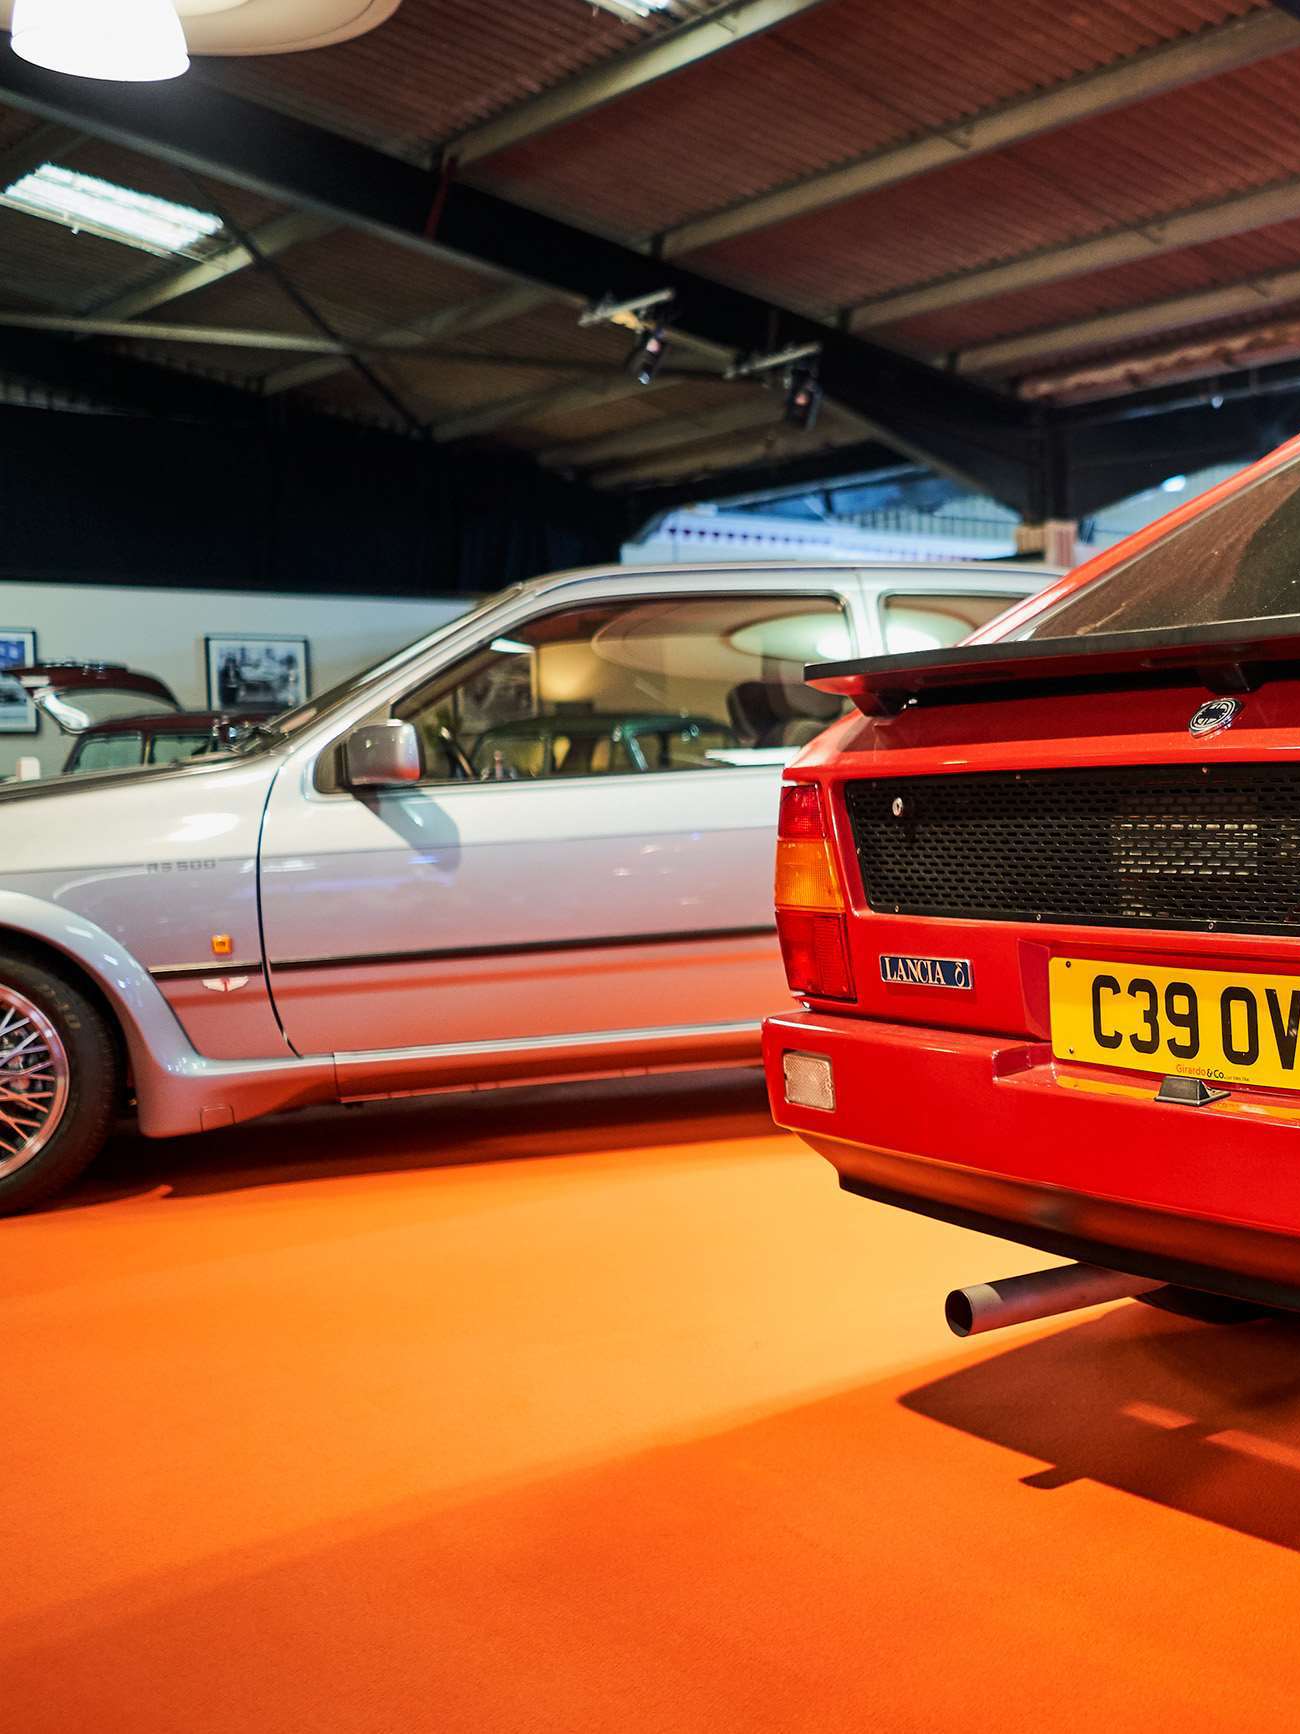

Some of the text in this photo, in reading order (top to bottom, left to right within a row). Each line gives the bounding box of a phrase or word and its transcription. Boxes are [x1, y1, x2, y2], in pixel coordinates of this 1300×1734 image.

[176, 859, 216, 872] 500
[884, 957, 946, 985] LANCIA
[1091, 974, 1201, 1060] C39
